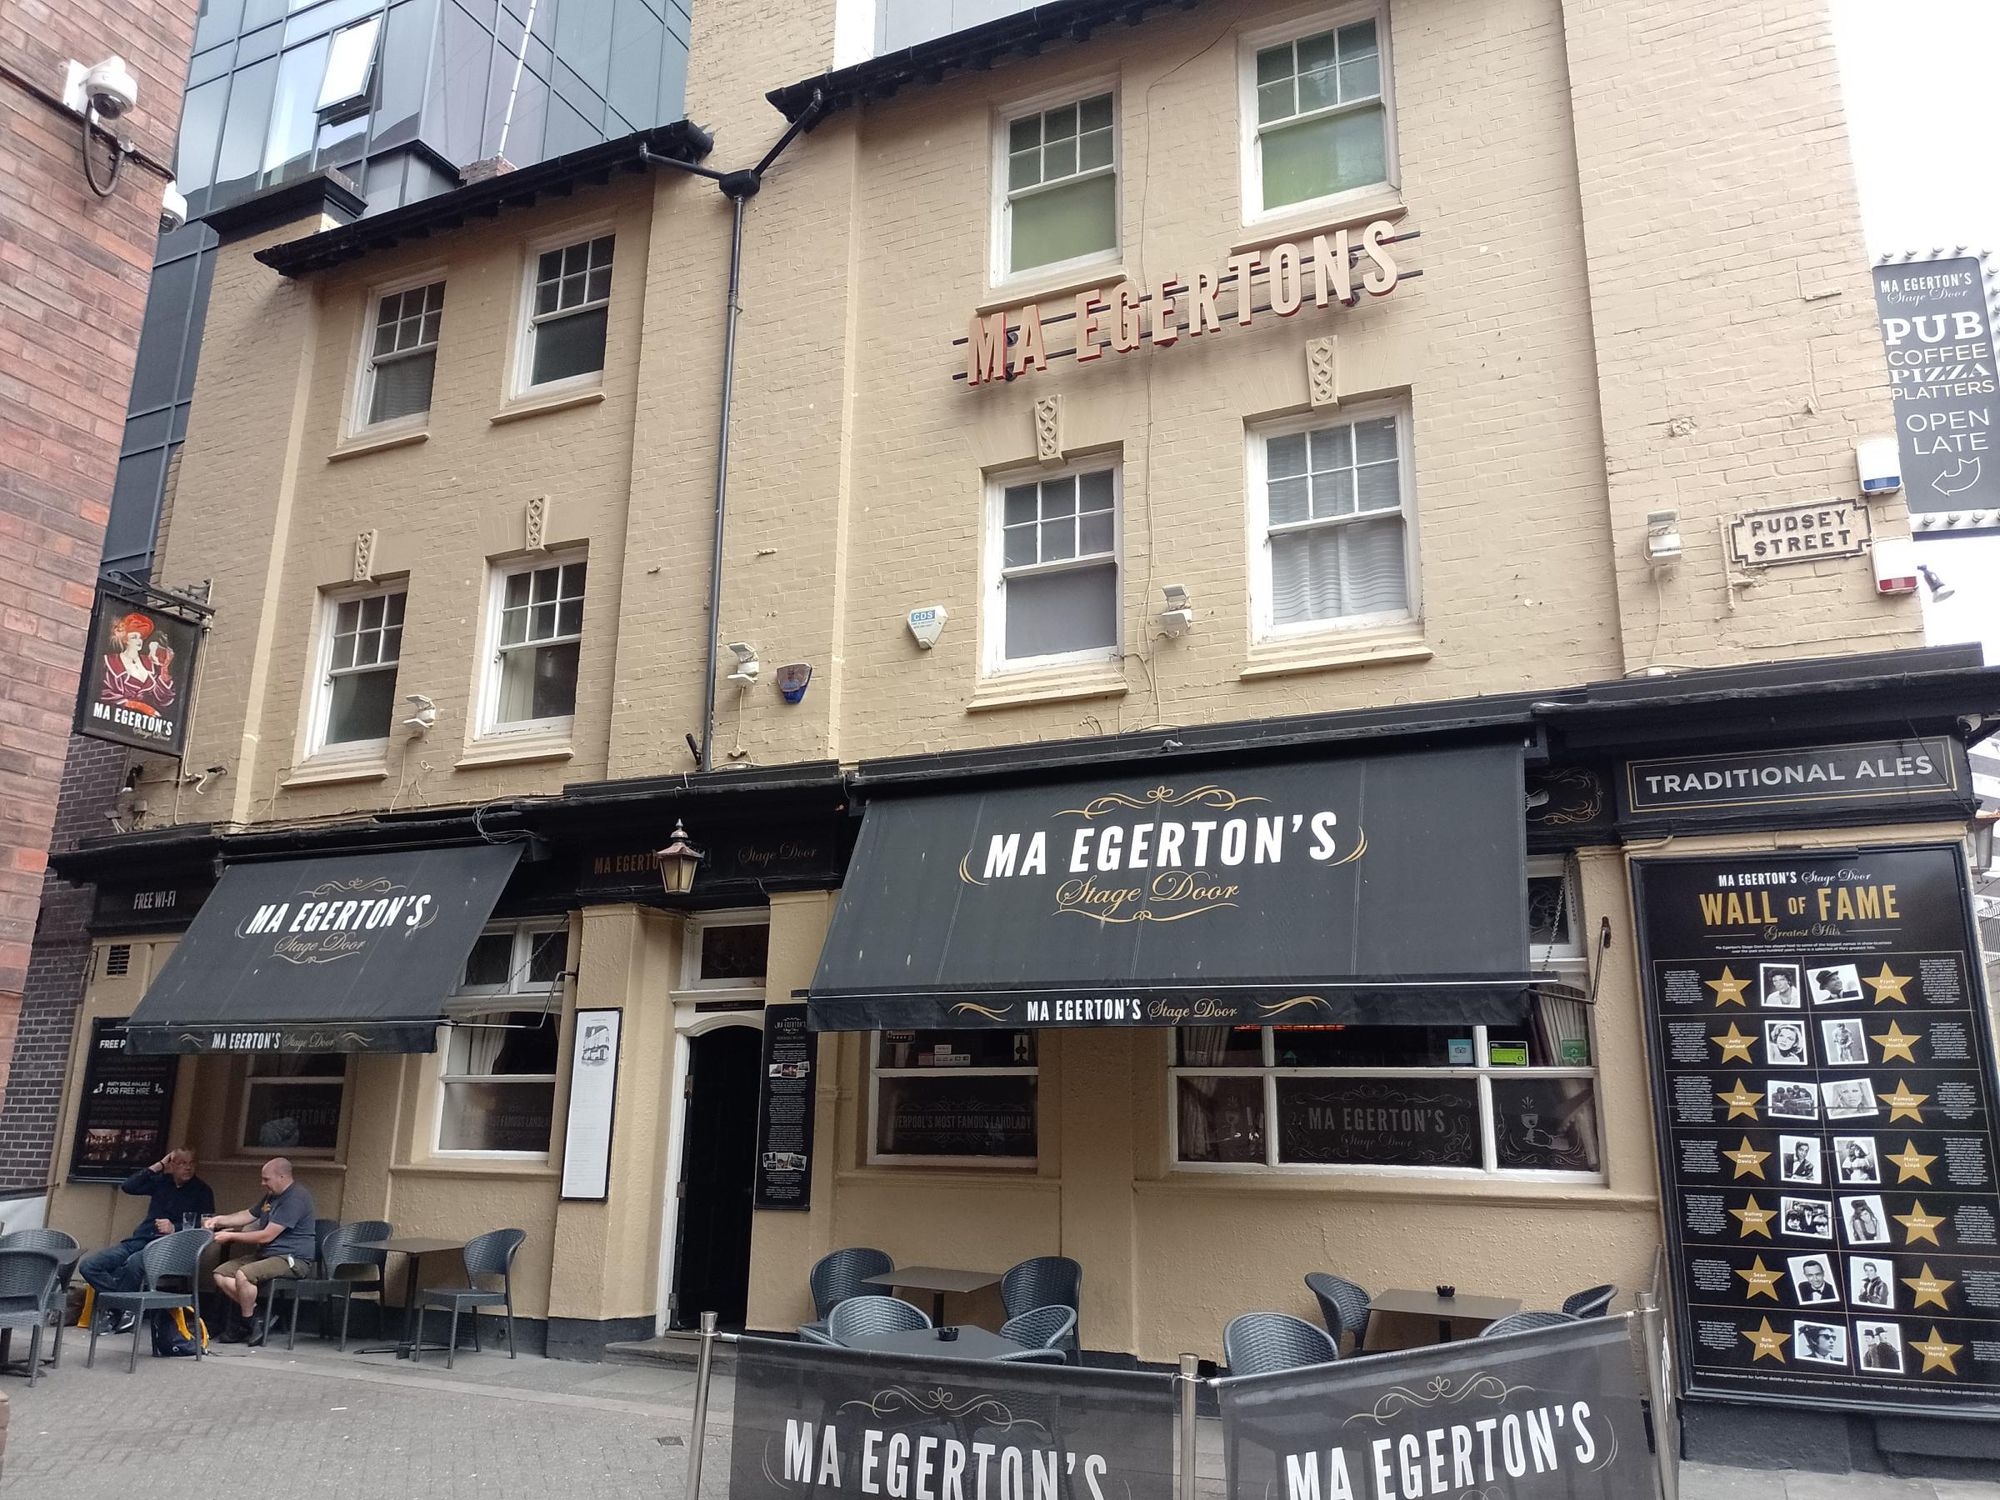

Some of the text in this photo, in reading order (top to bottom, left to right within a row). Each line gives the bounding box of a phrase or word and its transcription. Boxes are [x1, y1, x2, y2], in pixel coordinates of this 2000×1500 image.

[1880, 272, 1972, 294] MA EGERTON'S
[1887, 286, 1968, 306] Stage Door
[967, 219, 1398, 385] MA EGERTONS
[1883, 311, 1984, 345] PUB
[1887, 343, 1988, 366] COFFEE
[1890, 363, 1991, 384] PIZZA
[1891, 379, 1995, 401] PLATTERS
[1906, 408, 1990, 433] OPEN
[1913, 432, 1989, 455] LATE
[1751, 509, 1847, 537] PUDSEY
[1754, 529, 1850, 556] STREET
[913, 611, 934, 621] CDS
[93, 702, 173, 736] MA EGERTON'S
[1645, 755, 1934, 794] TRADITIONAL ALES
[738, 841, 817, 868] Stage Door
[984, 811, 1338, 879] MA EGERTON'S
[593, 856, 612, 875] MA
[1718, 868, 1872, 887] MA EGERTON'S Stage Door
[133, 890, 177, 911] FREE WI-FI
[1056, 870, 1240, 917] Stage Door
[1699, 884, 1901, 926] WALL OF FAME
[245, 894, 432, 935] MA EGERTON'S
[1764, 922, 1841, 941] Greatest Hits
[273, 931, 366, 959] Stage Door
[1027, 998, 1238, 1025] MA EGERTON'S Stage Door
[99, 1039, 120, 1049] FREE
[212, 1032, 334, 1053] MA EGERTON'S Stage Door
[106, 1087, 151, 1095] FOR FREE HIRE
[1308, 1108, 1447, 1134] MA EGERTON'S
[784, 1419, 1107, 1500] MA EGERTON'S
[1286, 1401, 1596, 1500] MA EGERTON'S
